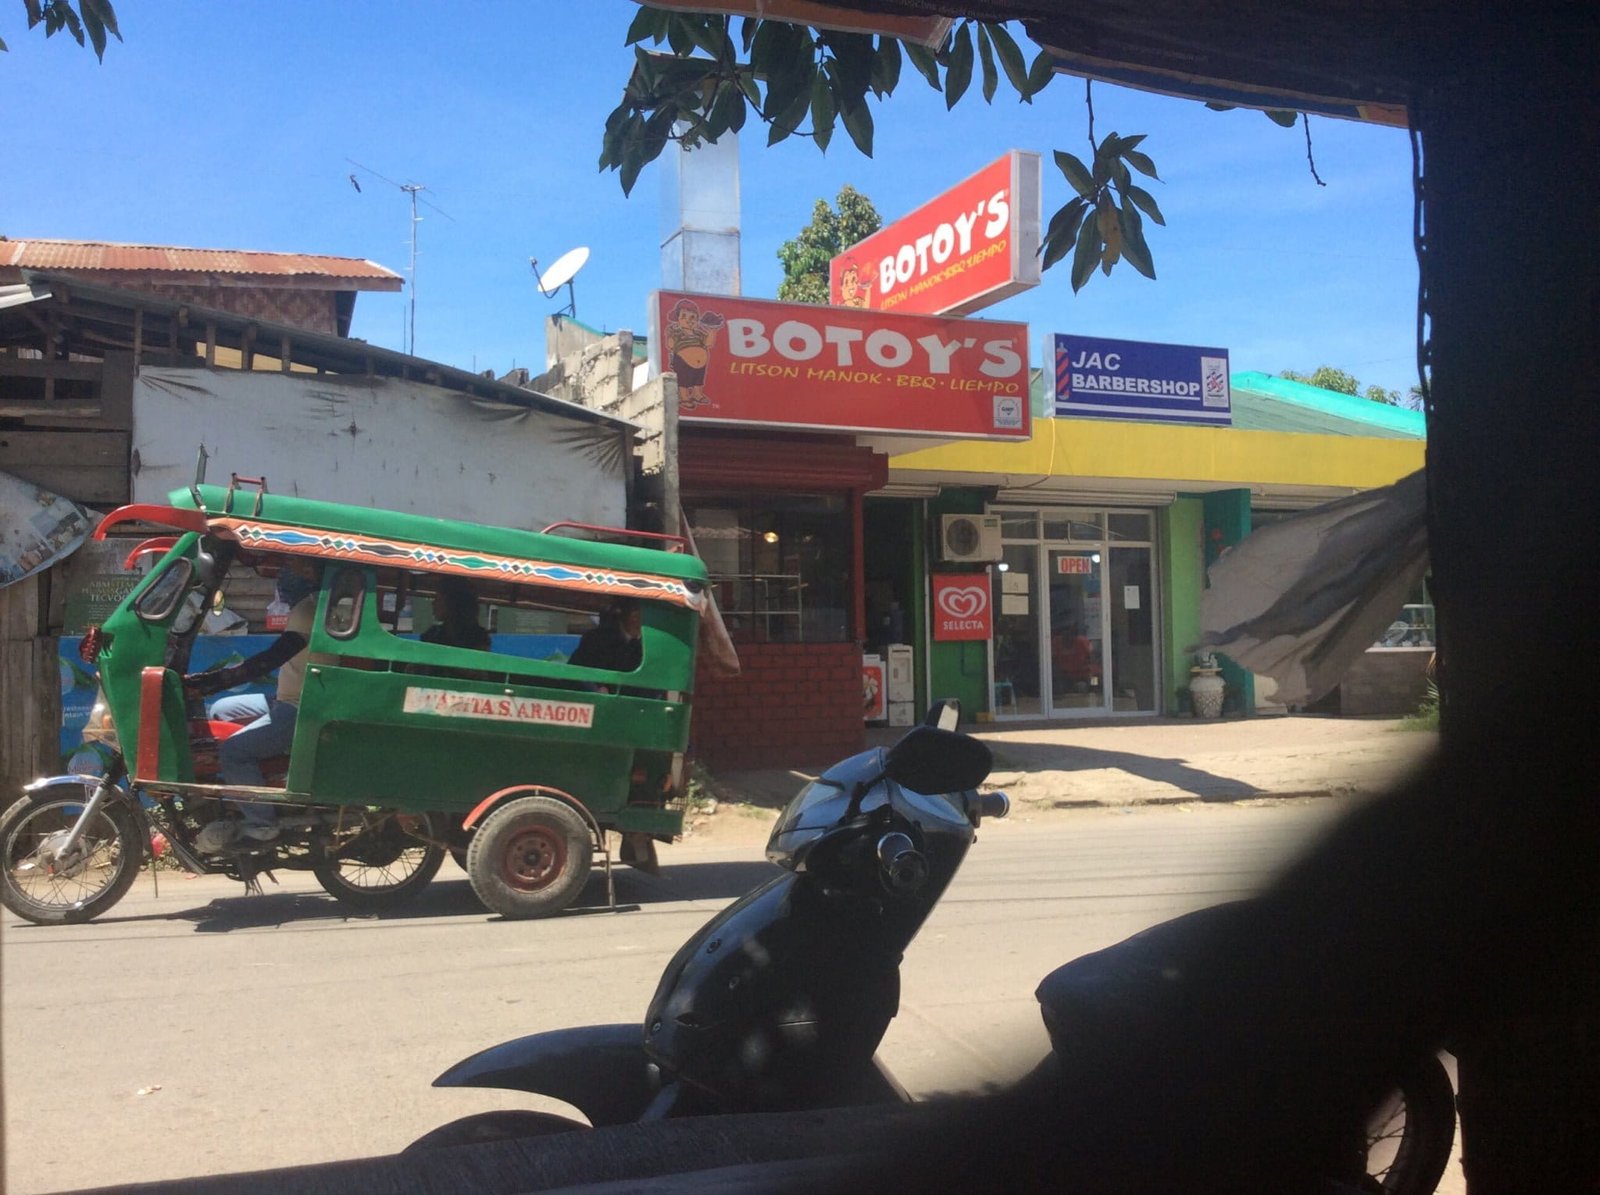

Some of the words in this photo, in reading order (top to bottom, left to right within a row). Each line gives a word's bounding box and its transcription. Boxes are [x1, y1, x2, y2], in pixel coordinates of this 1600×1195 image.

[879, 188, 1010, 294] BOTOY'S
[726, 317, 1023, 378] BOTOY'S
[1071, 350, 1121, 371] JAC
[729, 362, 799, 379] LITSON
[807, 367, 882, 386] MANOK
[896, 375, 936, 390] BBQ
[950, 378, 1020, 395] LIEMPO
[1071, 373, 1201, 396] BARBERSHOP
[1060, 557, 1090, 573] OPEN
[943, 620, 984, 631] SELECTA
[516, 702, 590, 724] ARAGON
